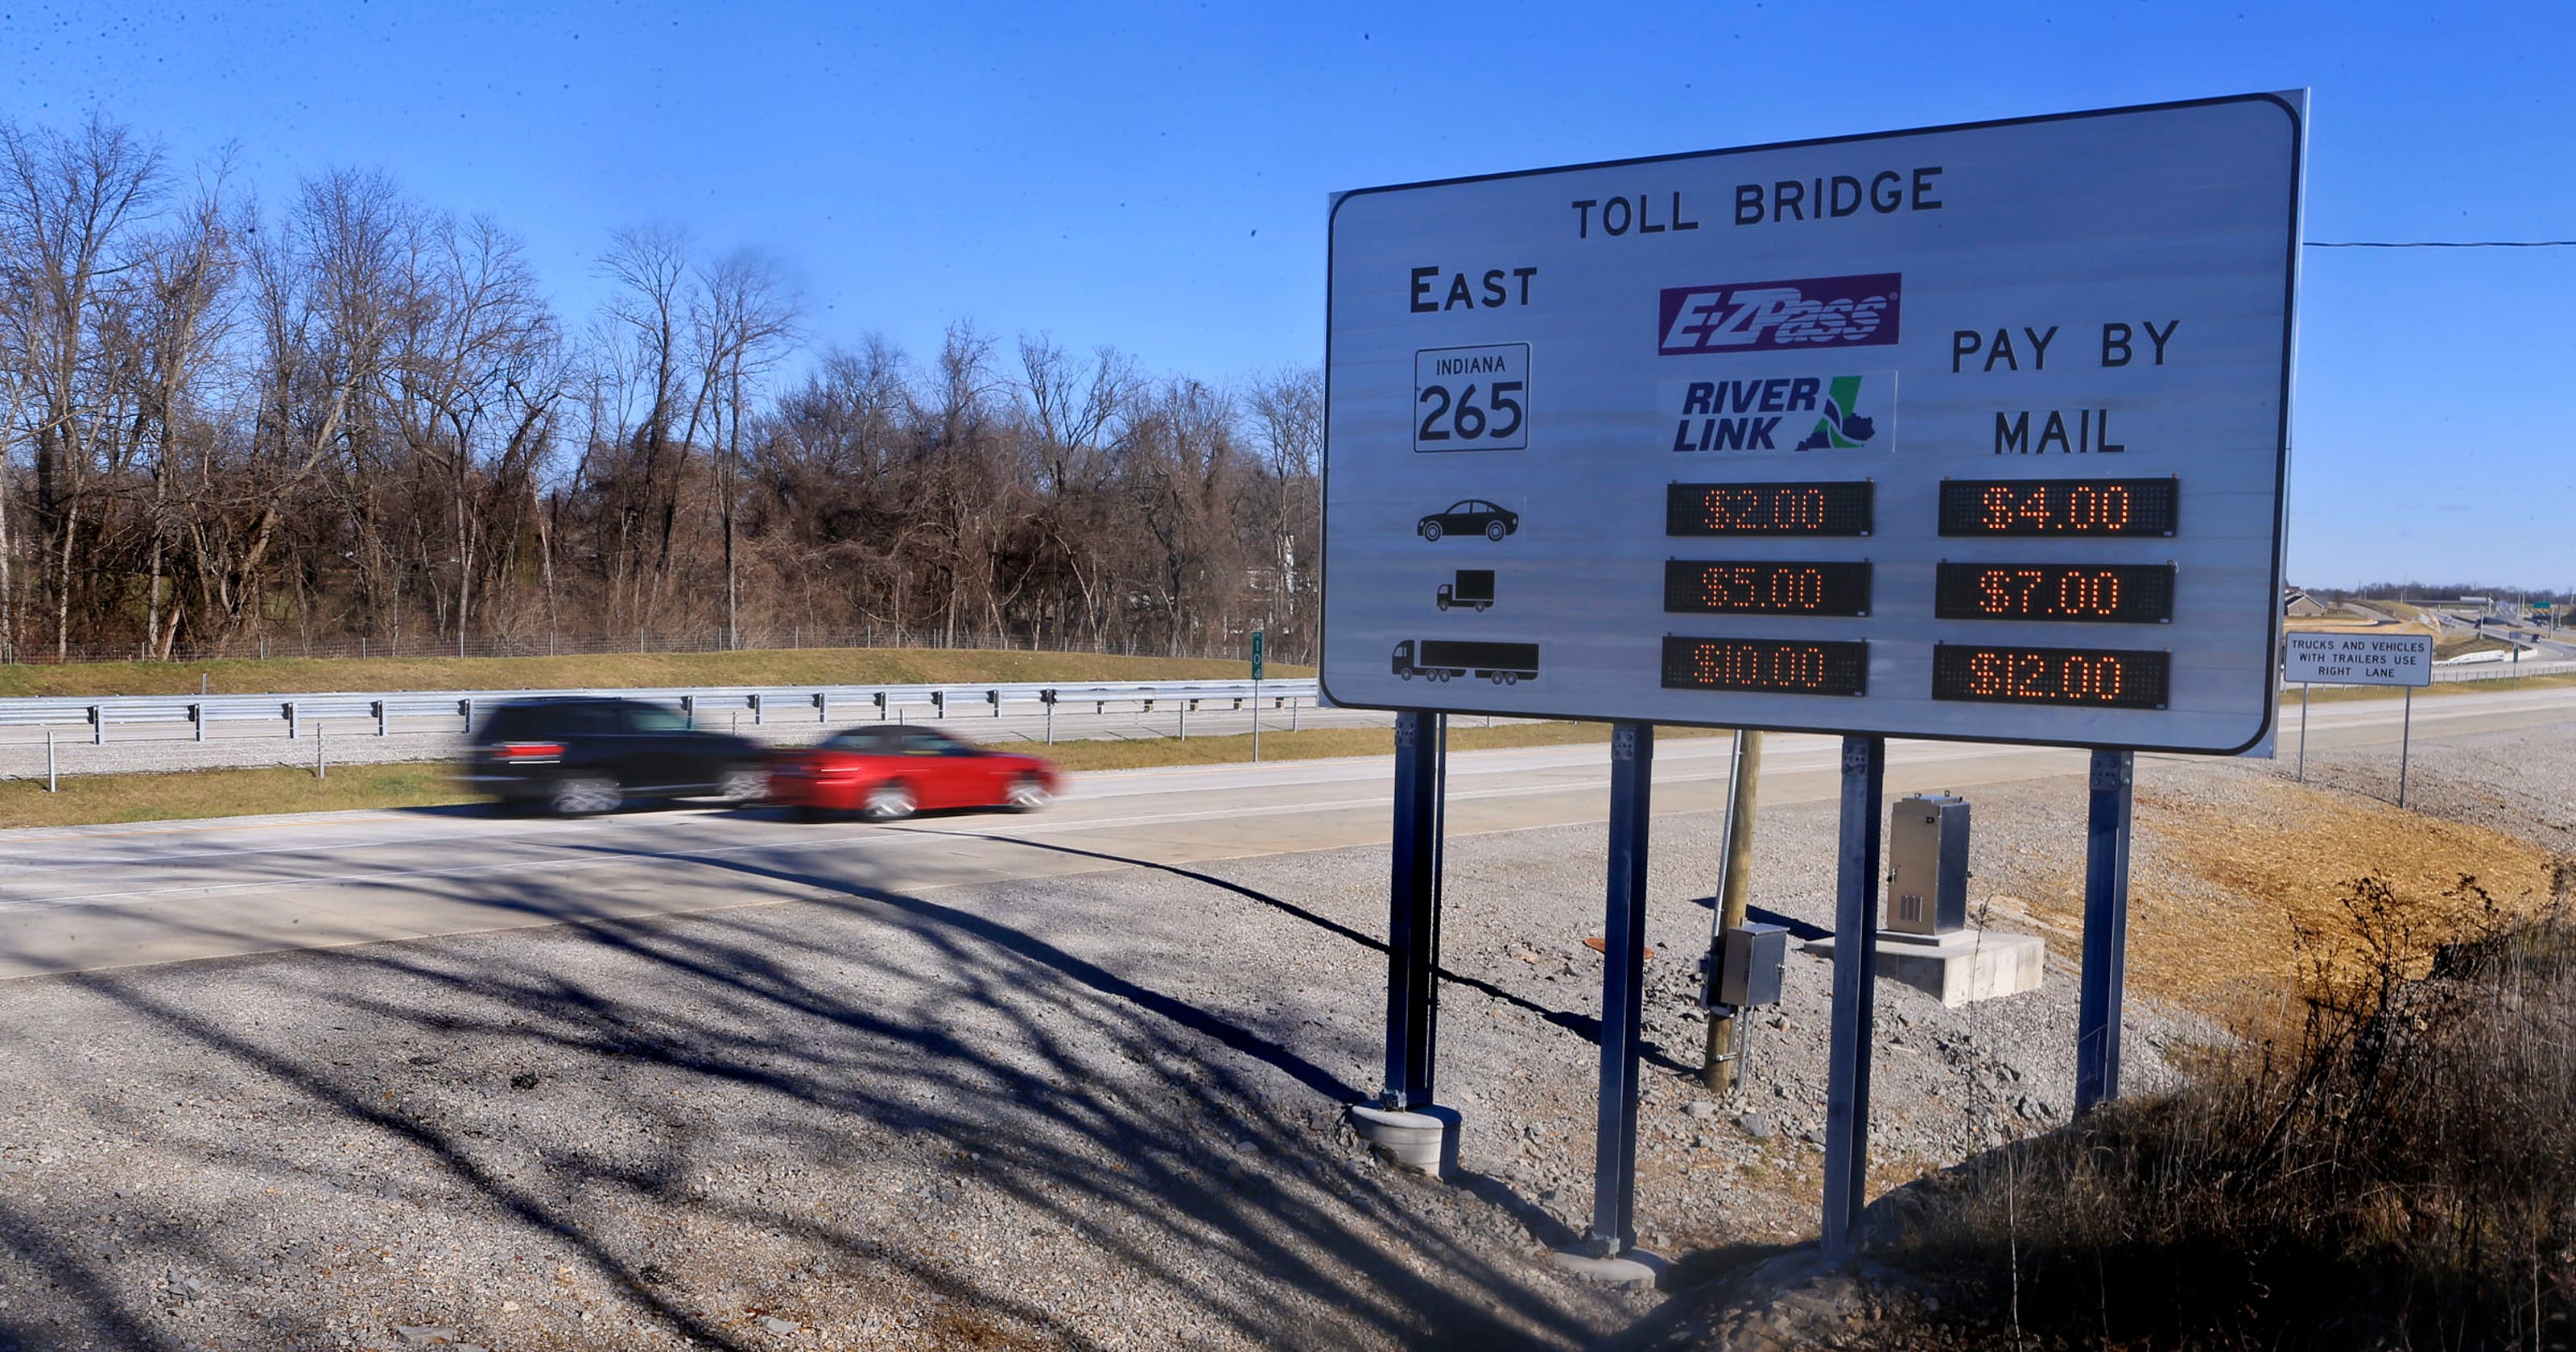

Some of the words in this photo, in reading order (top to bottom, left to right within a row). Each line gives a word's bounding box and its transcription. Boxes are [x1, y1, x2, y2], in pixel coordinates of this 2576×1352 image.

[1572, 191, 1699, 239] TOLL
[1735, 167, 1942, 225] BRIDGE
[1410, 266, 1537, 312] EAST
[1436, 355, 1505, 375] INDIANA
[1952, 326, 2058, 373] PAY
[2101, 320, 2180, 367] BY
[1418, 381, 1523, 441] 265
[1682, 376, 1821, 415] RIVER
[1672, 417, 1781, 452] LINK
[1996, 409, 2125, 455] MAIL
[1703, 488, 1824, 530] $2.00
[1983, 485, 2128, 530] $4.00
[1702, 567, 1822, 608] $5.00
[1979, 571, 2119, 615] $7.00
[1694, 645, 1824, 688] $10.00
[2292, 640, 2334, 649] TRUCKS
[2342, 641, 2365, 651] AND
[2372, 642, 2425, 652] VEHICLES
[2299, 653, 2325, 662] WITH
[2333, 653, 2387, 664] TRAILERS
[2394, 655, 2417, 666] USE
[1969, 653, 2121, 700] $12.00
[2318, 666, 2351, 676] RIGHT
[2365, 668, 2395, 678] LANE
